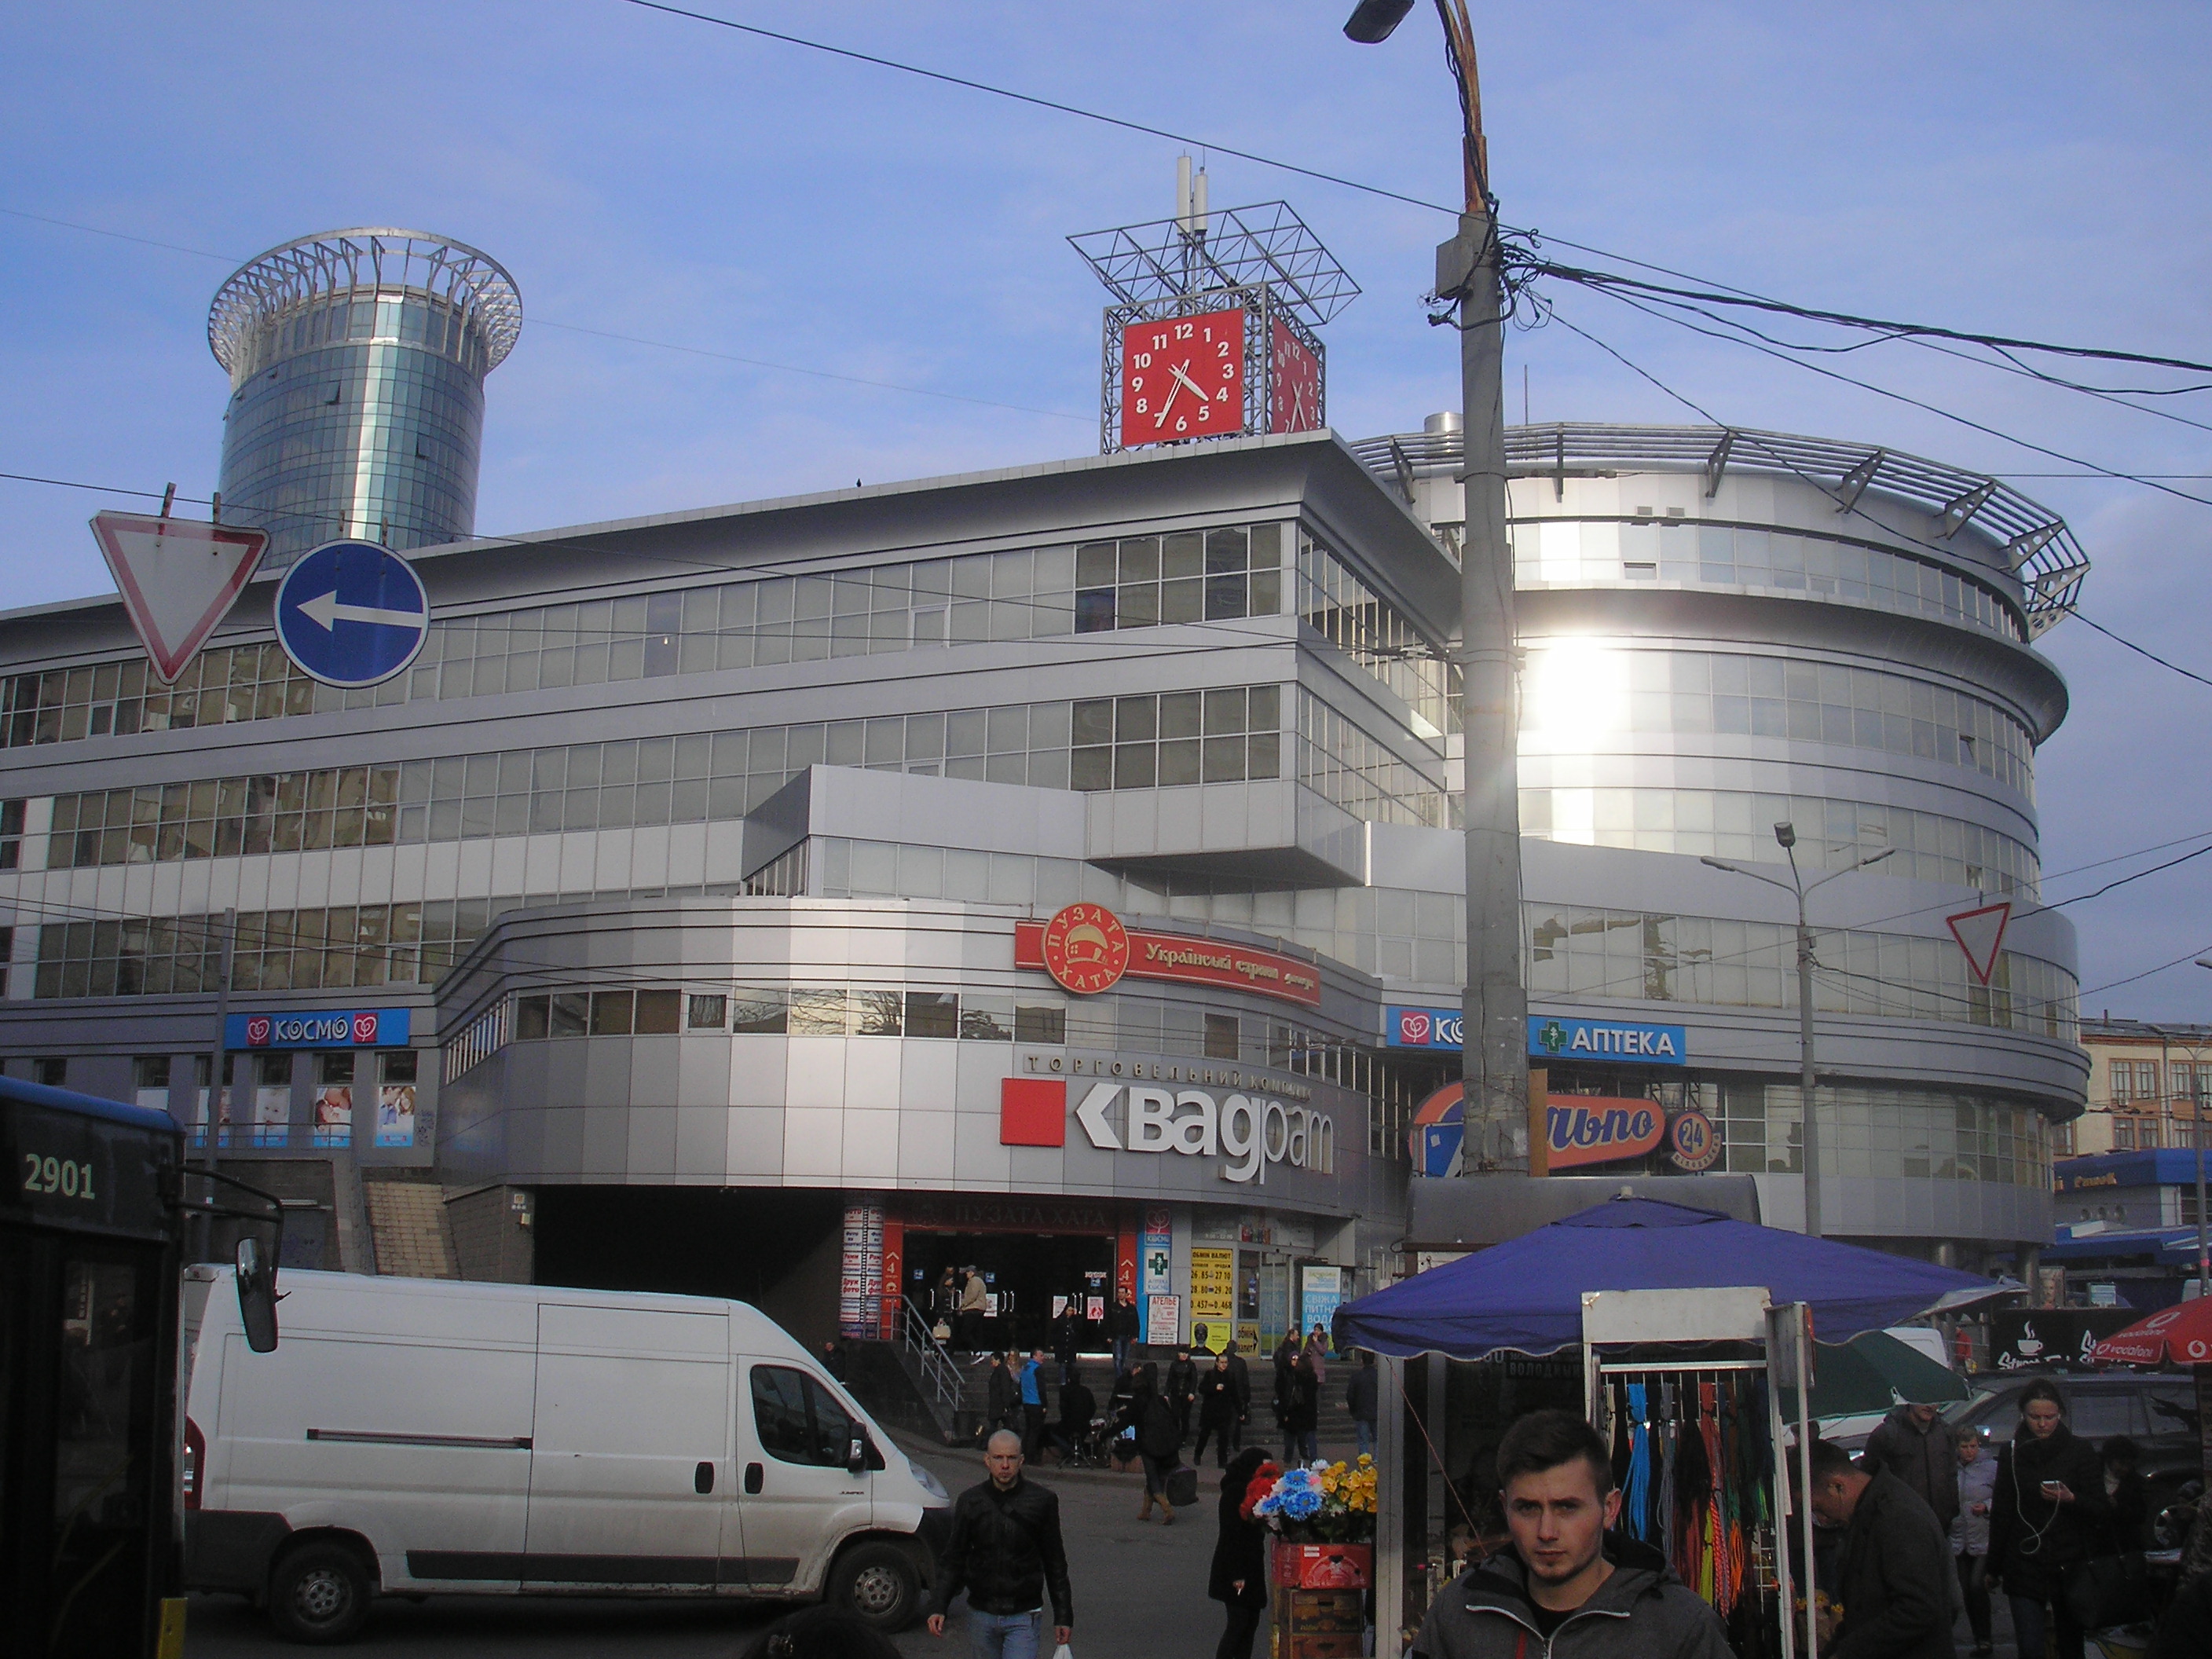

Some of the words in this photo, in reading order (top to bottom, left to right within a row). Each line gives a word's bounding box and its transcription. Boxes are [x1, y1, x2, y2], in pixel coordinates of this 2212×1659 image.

[1174, 323, 1194, 340] 12
[1203, 327, 1211, 342] 1
[1152, 334, 1168, 350] 11
[1218, 341, 1229, 357] 2
[1133, 353, 1152, 369] 10
[1222, 363, 1234, 379] 3
[1132, 376, 1144, 393] 9
[1216, 386, 1229, 402] 4
[1136, 398, 1148, 414] 8
[1199, 405, 1210, 422] 5
[1175, 416, 1187, 432] 6
[1047, 906, 1124, 953] ПУЗАТА
[1145, 943, 1232, 971] Українські
[1058, 965, 1116, 988] ХАТА
[1572, 1027, 1675, 1057] АПТЕКА
[1028, 1056, 1242, 1086] ТОРГОВЕЛЬНИЙ
[1683, 1122, 1703, 1147] 24
[24, 1153, 95, 1199] 2901
[887, 1262, 895, 1273] 4
[1152, 1297, 1177, 1306] АТЕЛЬЕ
[1306, 1295, 1337, 1304] СВІЖА
